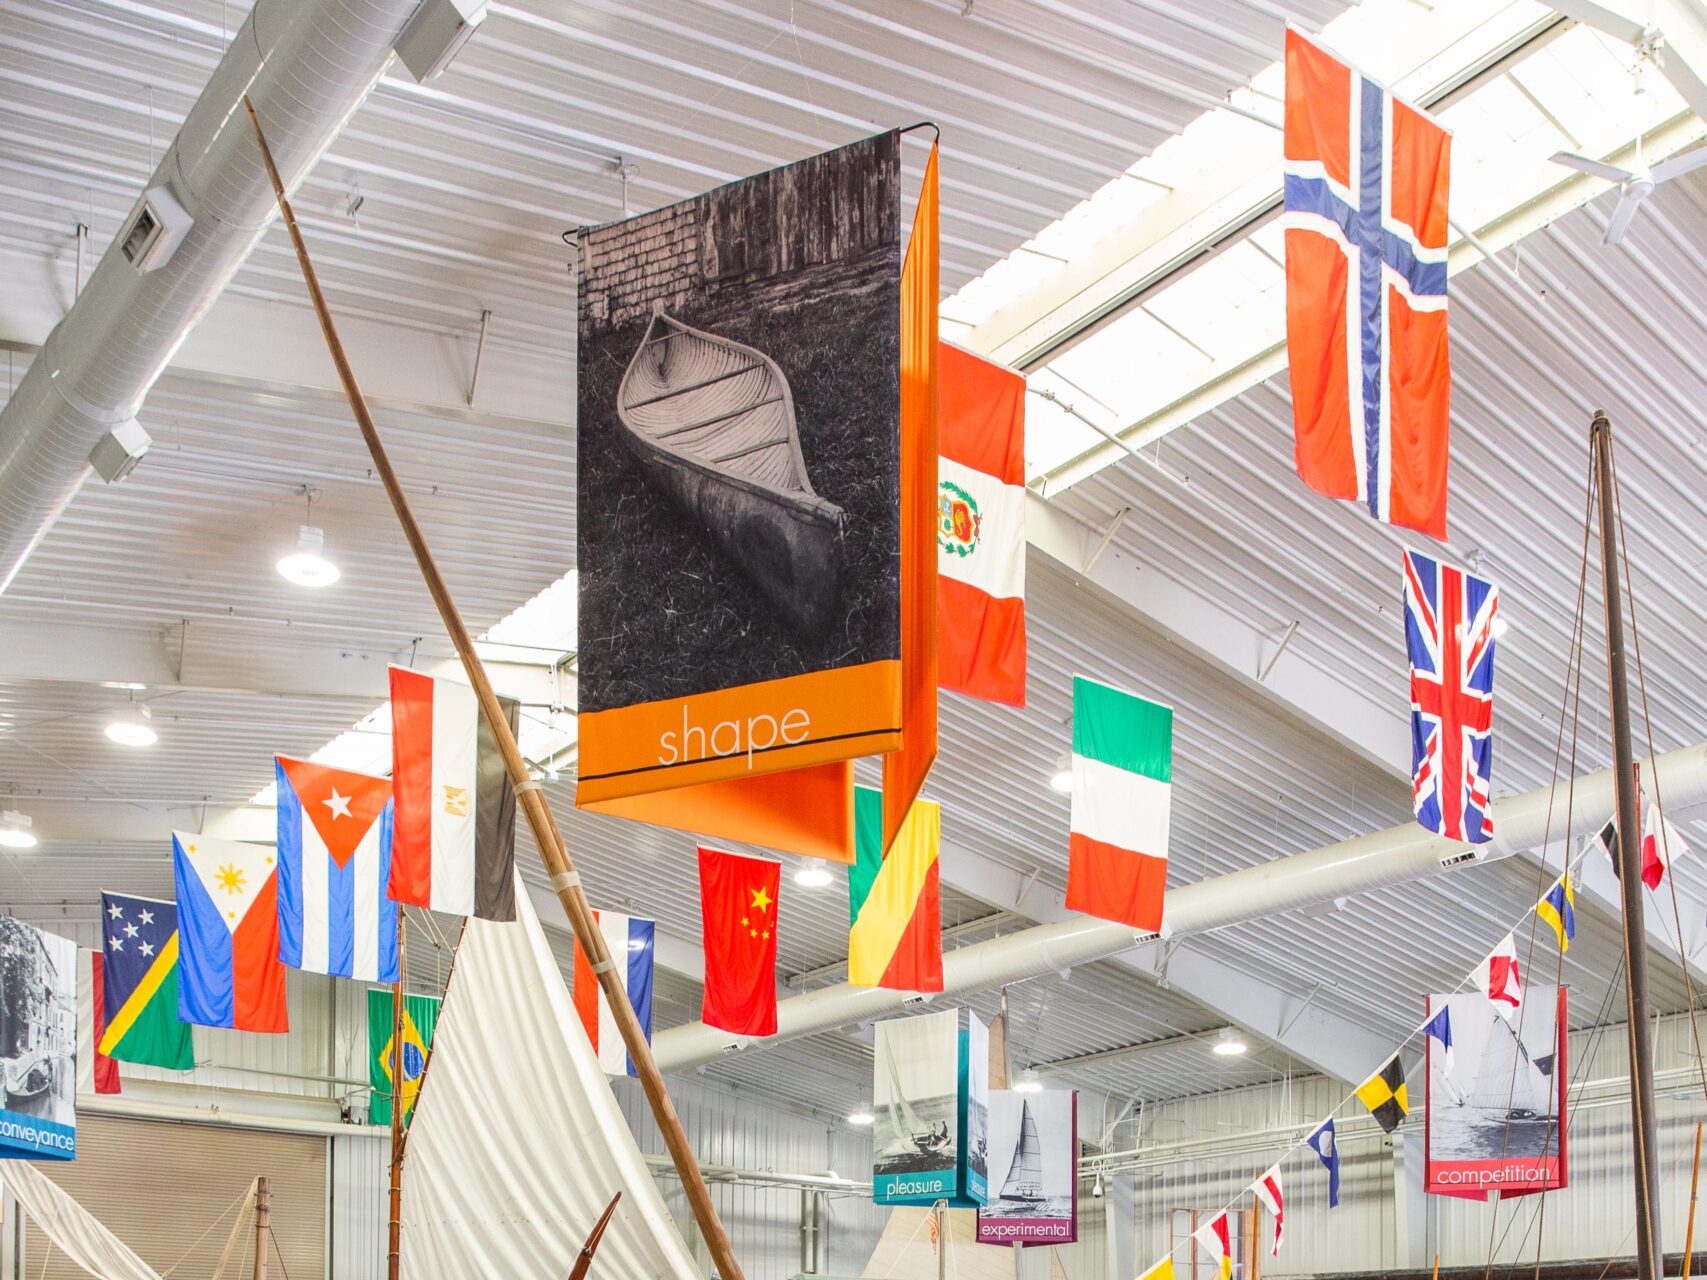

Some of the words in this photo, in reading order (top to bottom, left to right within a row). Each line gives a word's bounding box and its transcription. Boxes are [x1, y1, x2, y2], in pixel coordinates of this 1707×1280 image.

[658, 704, 811, 770] shape
[886, 1175, 943, 1200] pleasure
[1437, 1164, 1551, 1189] competition
[981, 1221, 1070, 1240] experimental
